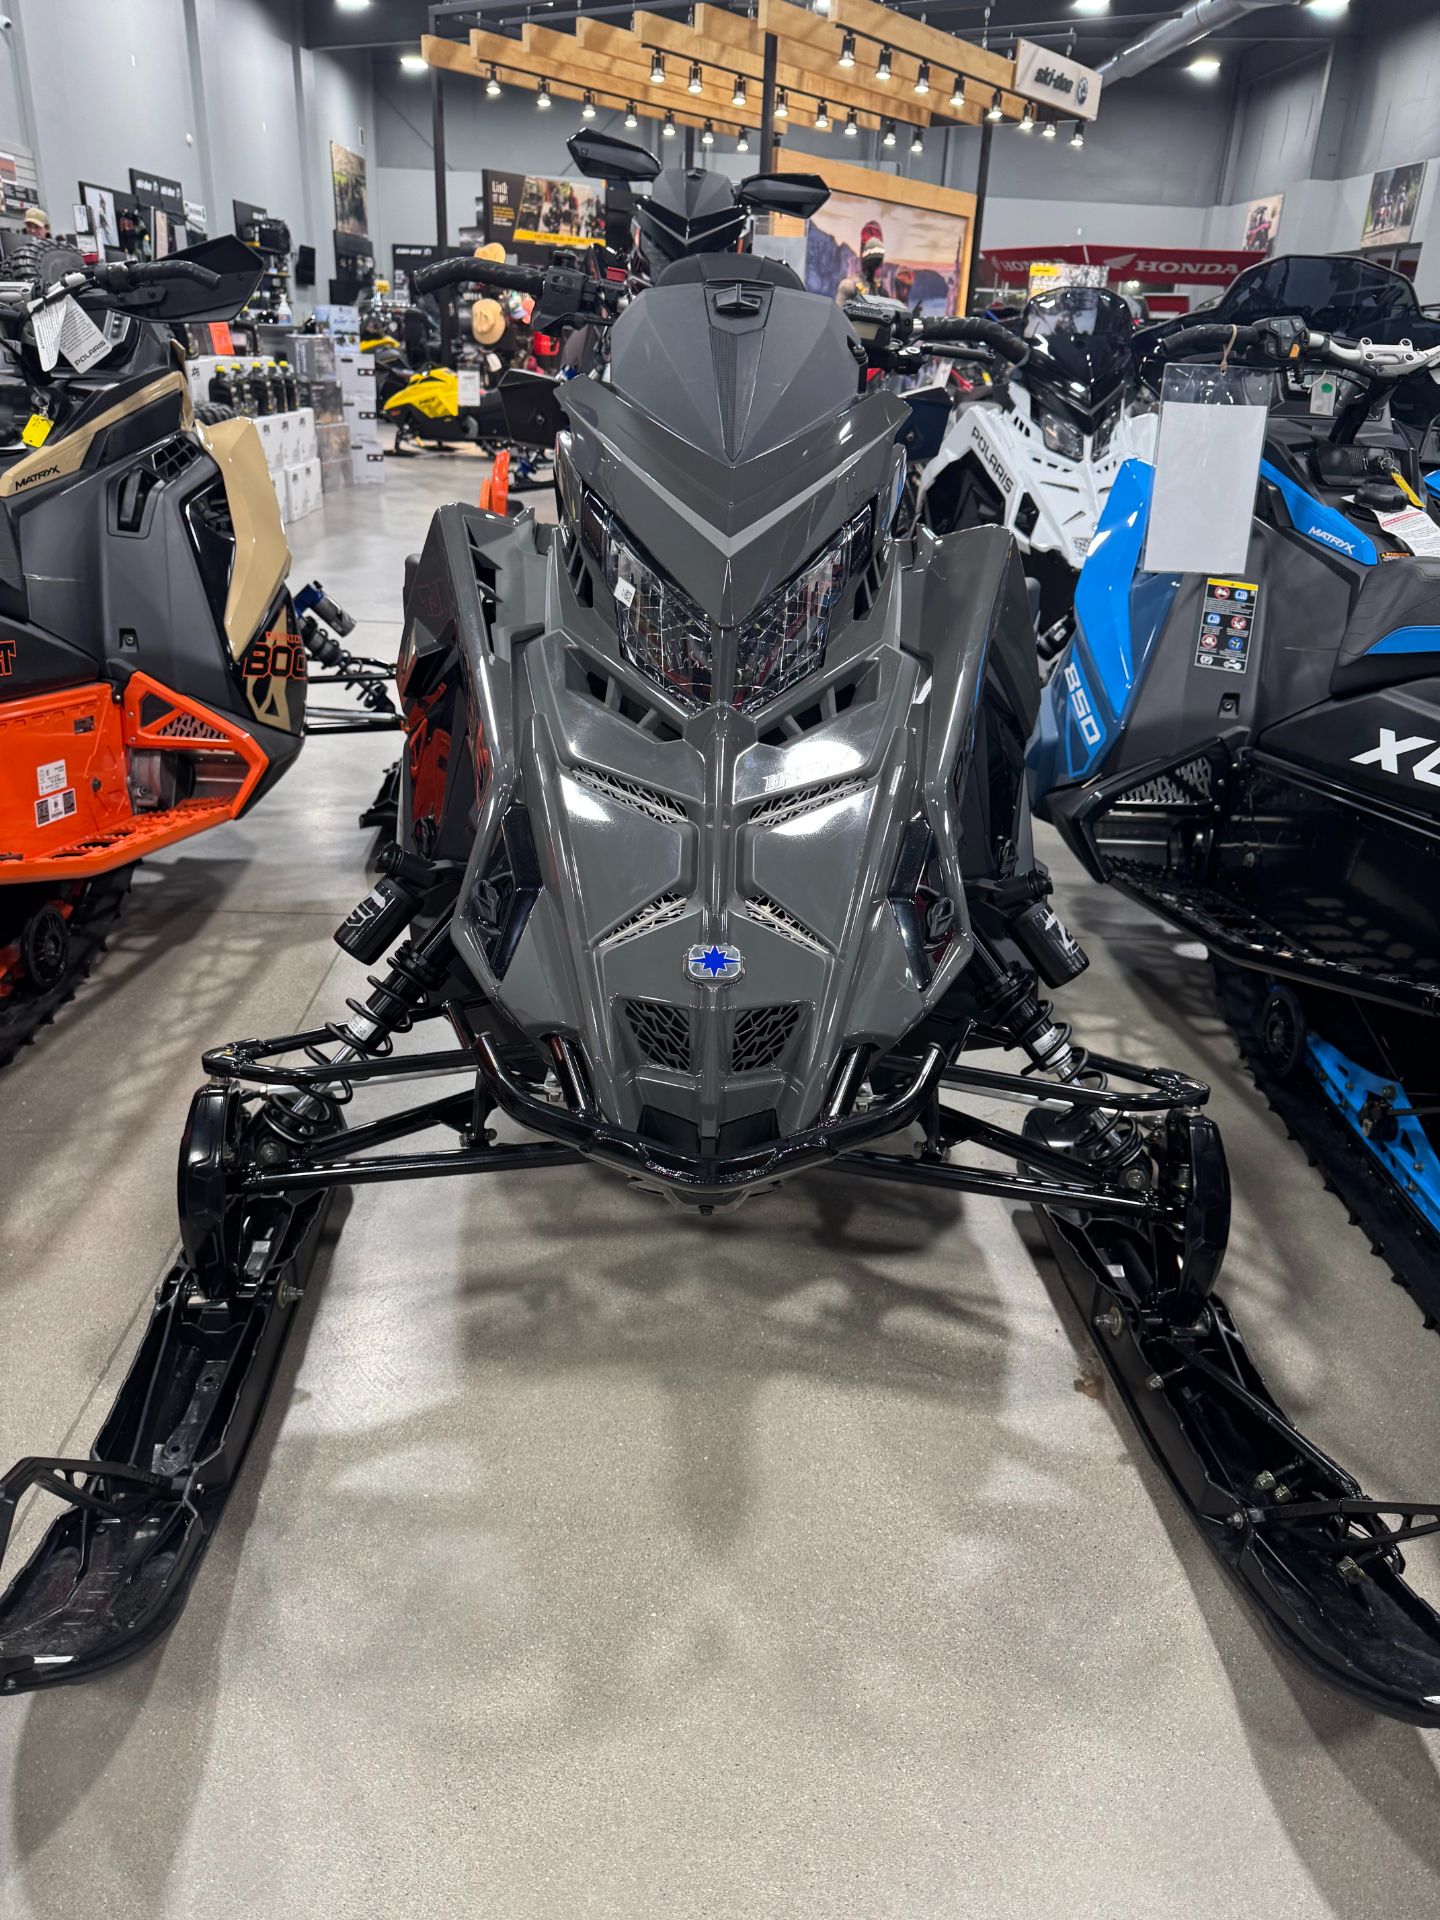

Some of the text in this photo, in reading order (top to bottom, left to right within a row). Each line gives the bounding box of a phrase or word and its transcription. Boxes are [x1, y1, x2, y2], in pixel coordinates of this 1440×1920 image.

[1135, 260, 1239, 275] HONDA
[74, 340, 107, 367] POLARIS
[971, 426, 1014, 494] POLARIS
[15, 464, 61, 491] MATRYX
[1308, 525, 1356, 555] MATRYX
[242, 641, 308, 680] 800
[1064, 661, 1101, 746] 850
